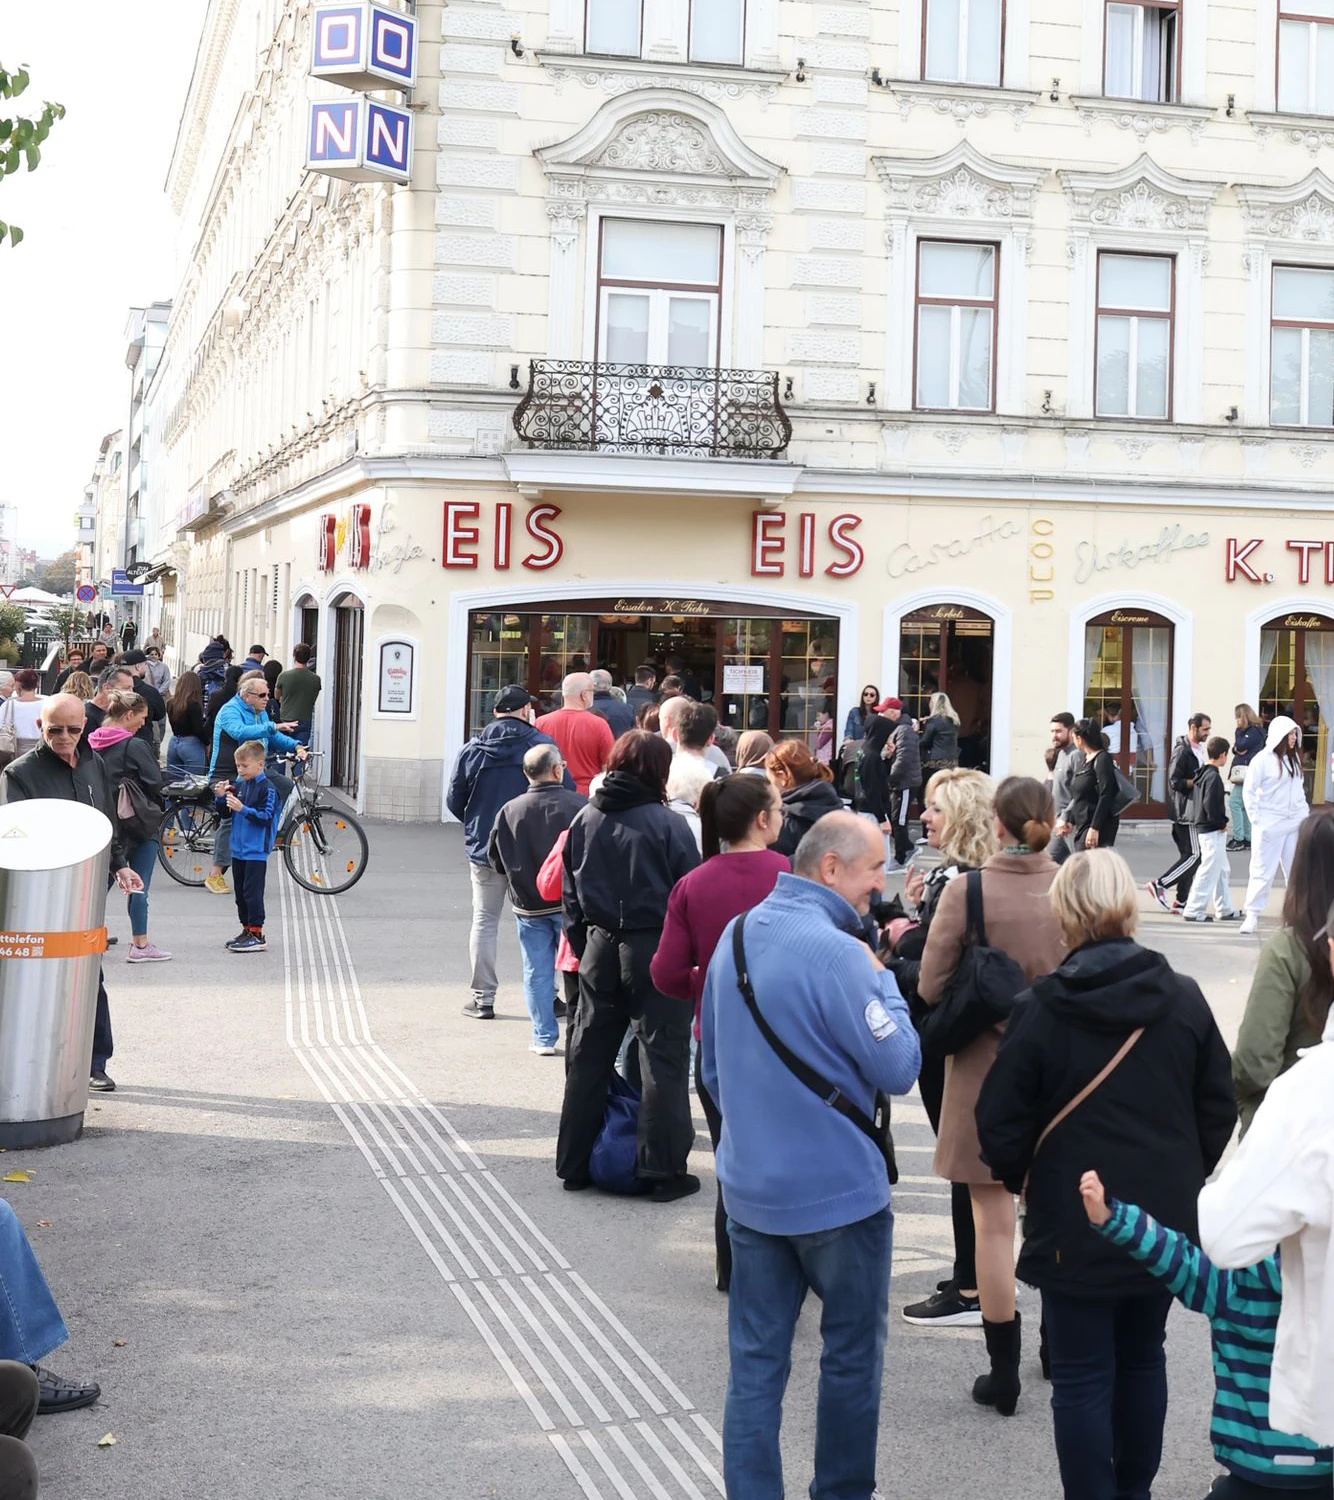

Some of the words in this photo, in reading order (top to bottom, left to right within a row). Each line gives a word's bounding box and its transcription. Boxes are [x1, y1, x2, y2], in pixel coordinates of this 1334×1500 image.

[443, 501, 564, 570] EIS
[751, 510, 865, 578] EIS
[1226, 538, 1271, 583] K.
[614, 599, 654, 613] Eissalon
[681, 600, 710, 615] Tichy
[931, 606, 965, 619] Sorbets
[1111, 610, 1149, 623] Eiscreme
[1284, 614, 1321, 628] Eiskaffee
[15, 947, 30, 957] 48
